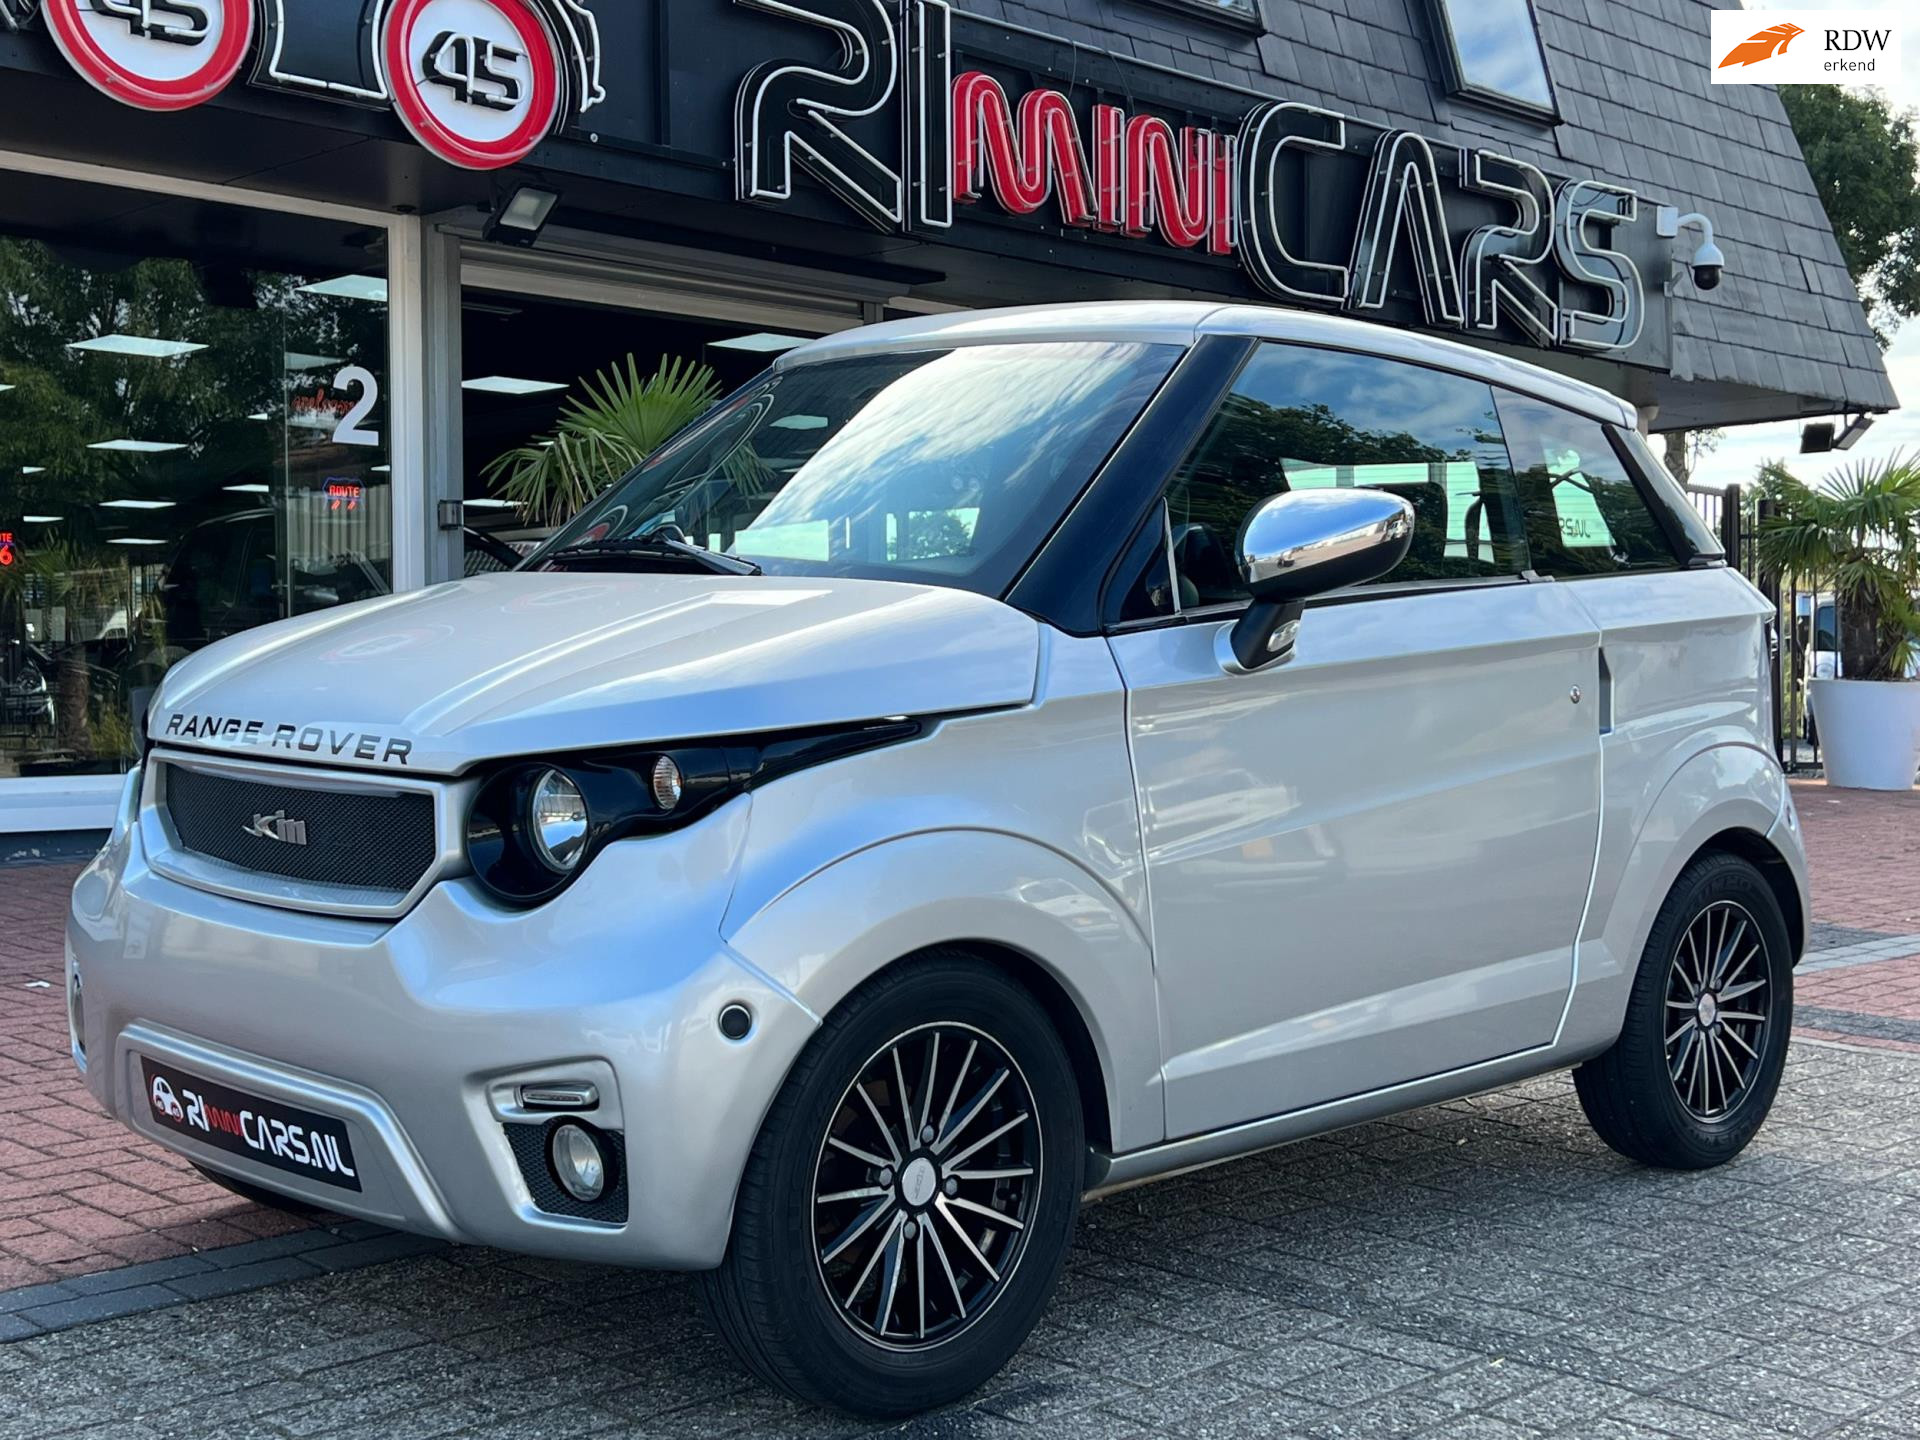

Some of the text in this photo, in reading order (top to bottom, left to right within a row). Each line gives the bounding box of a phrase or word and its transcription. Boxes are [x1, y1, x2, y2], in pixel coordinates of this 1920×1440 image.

[422, 30, 527, 112] 45
[332, 366, 380, 446] 2
[329, 484, 360, 498] ROUTE
[165, 713, 413, 765] RANGE ROVER
